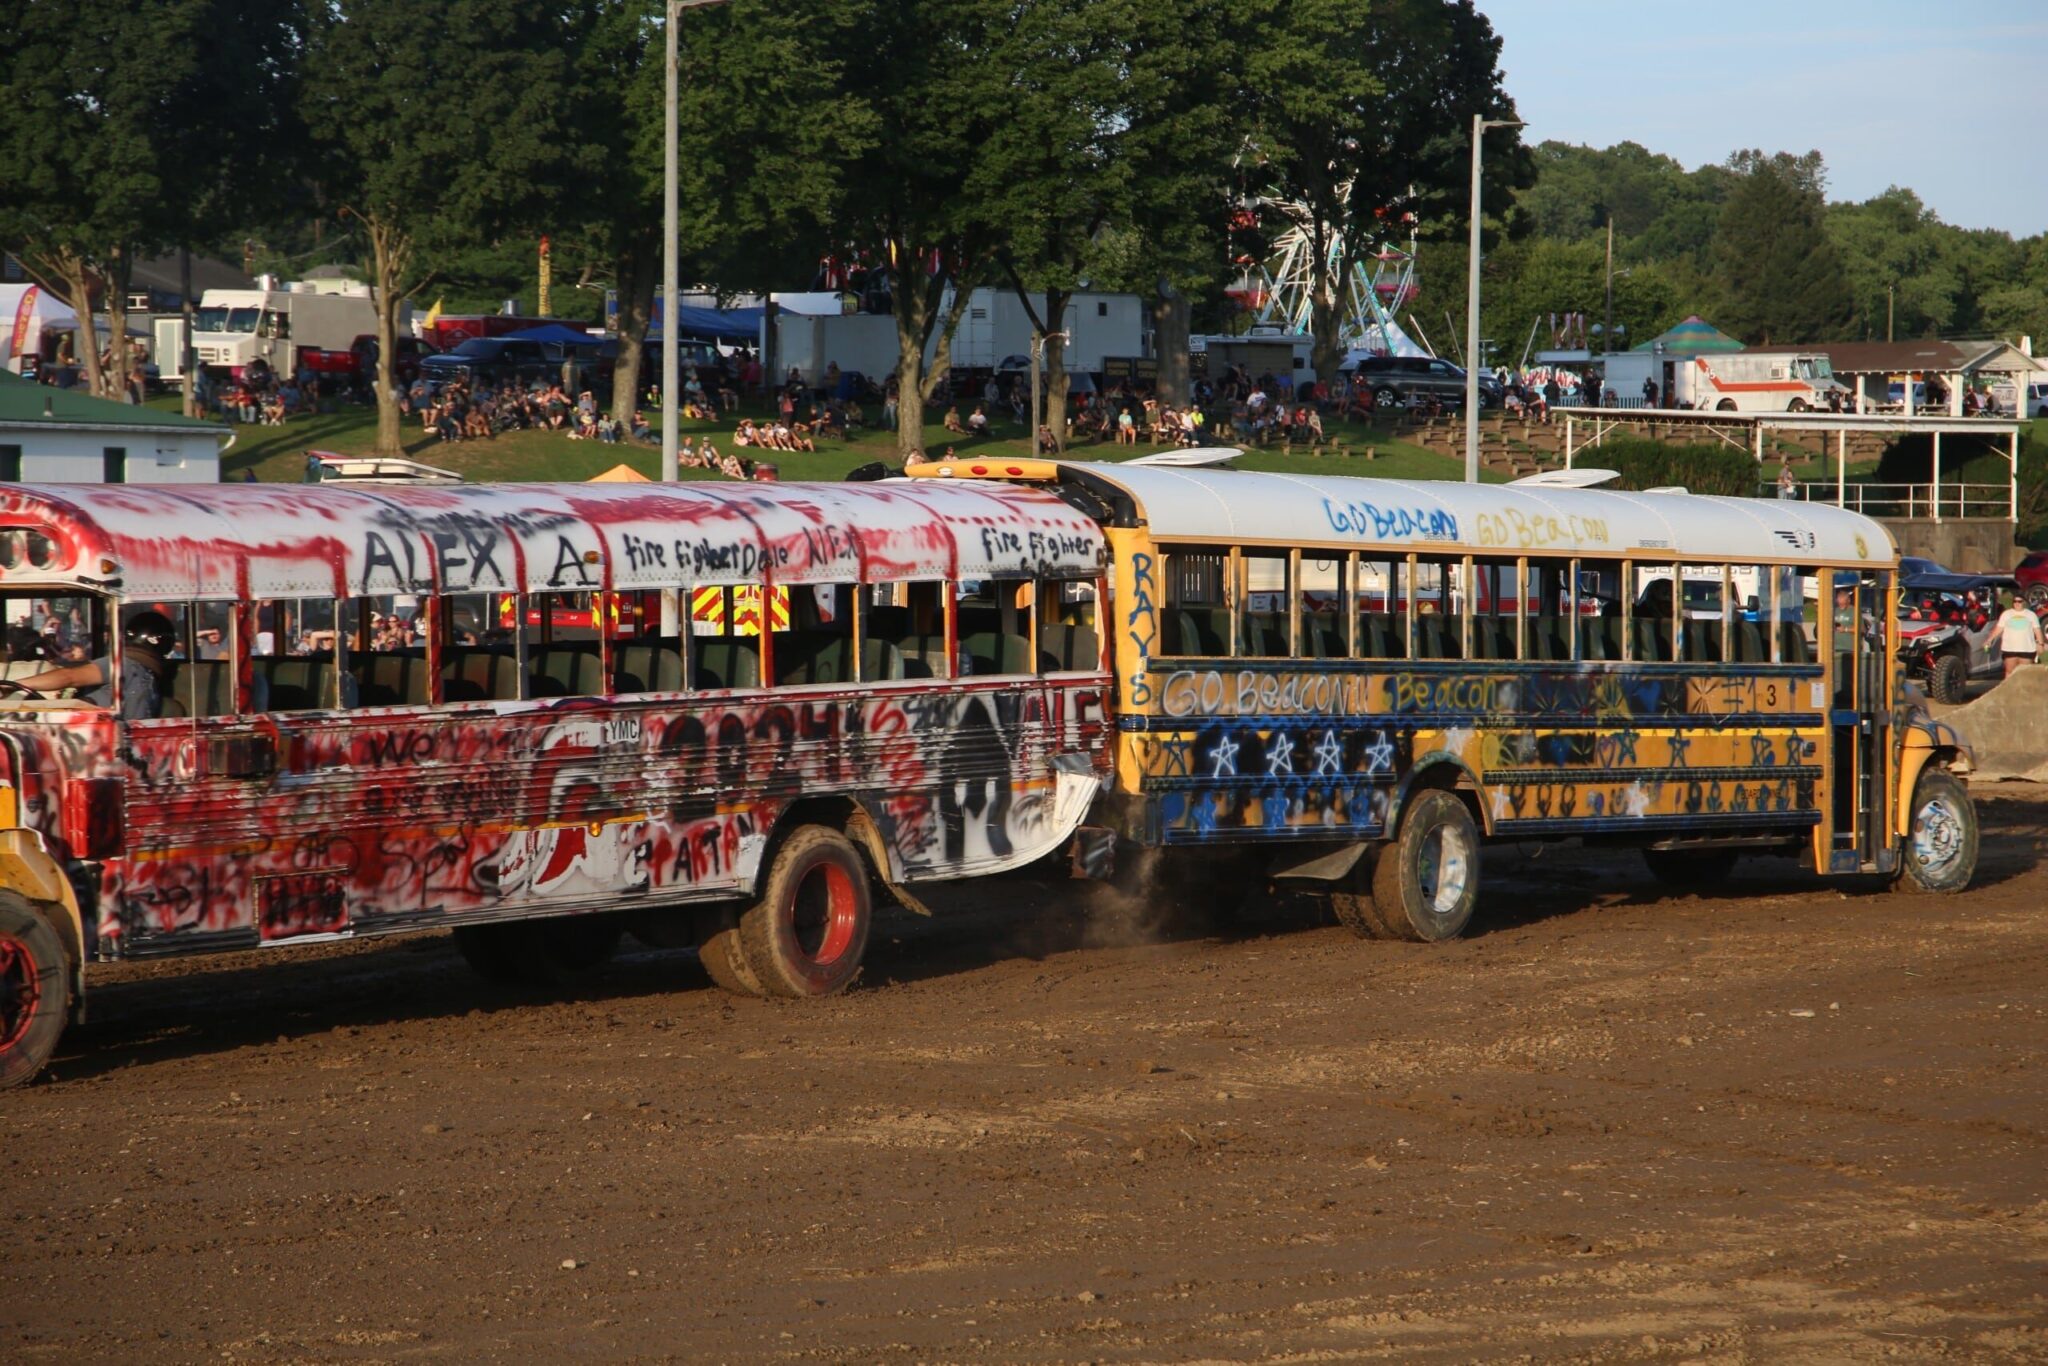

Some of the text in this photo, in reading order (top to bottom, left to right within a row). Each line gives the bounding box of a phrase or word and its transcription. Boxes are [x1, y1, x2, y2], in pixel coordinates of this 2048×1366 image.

[1162, 669, 1224, 717] GO
[1766, 684, 1777, 706] 3
[609, 719, 643, 742] YMC
